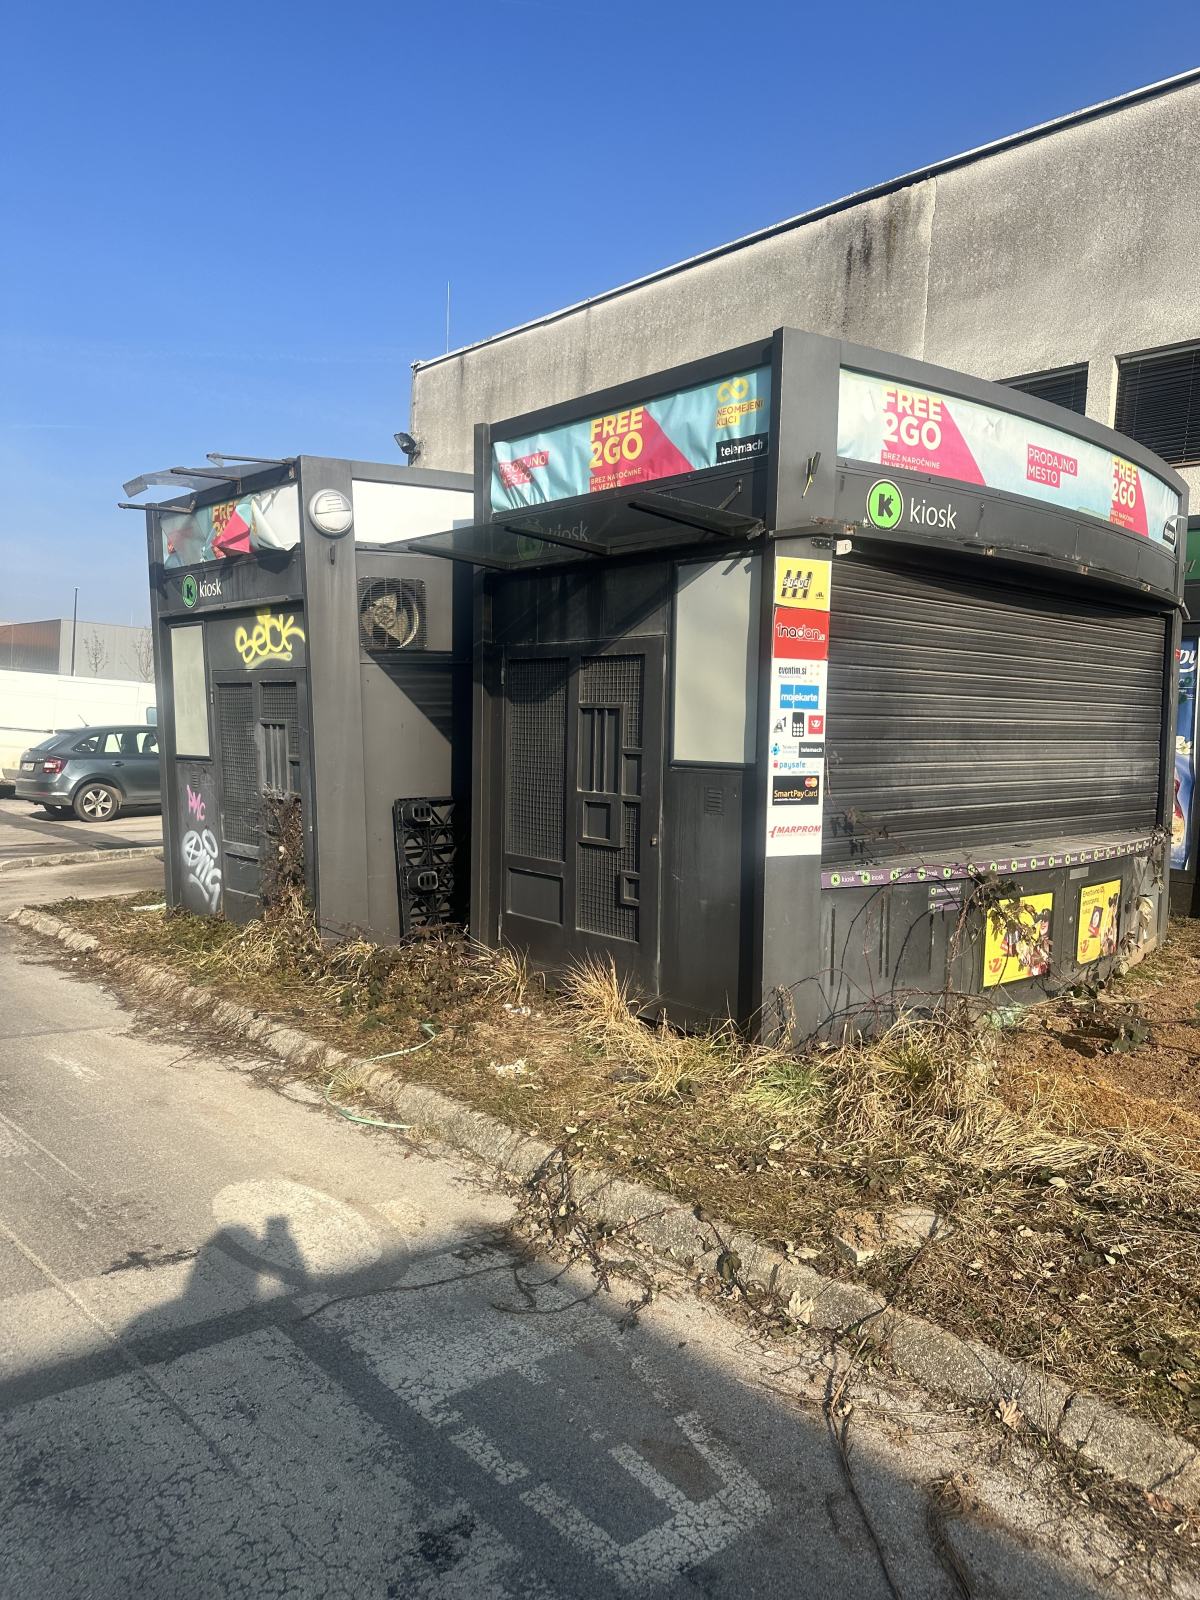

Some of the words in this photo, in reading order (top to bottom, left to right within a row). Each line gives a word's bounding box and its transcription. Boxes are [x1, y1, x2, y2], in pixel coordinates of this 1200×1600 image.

[717, 400, 763, 416] NEOMEJENI
[881, 386, 942, 421] FREE
[590, 406, 643, 441] FREE
[881, 411, 942, 450] 2GO
[589, 431, 643, 469] 2GO
[721, 439, 764, 456] telemach
[1028, 447, 1076, 473] PRODAJNO
[591, 476, 606, 485] BREZ
[1028, 464, 1058, 483] MESTO
[1111, 456, 1137, 485] FREE
[1111, 478, 1137, 508] 2GO
[910, 497, 957, 530] kiosk
[200, 578, 222, 597] kiosk
[776, 825, 822, 834] MARPROM
